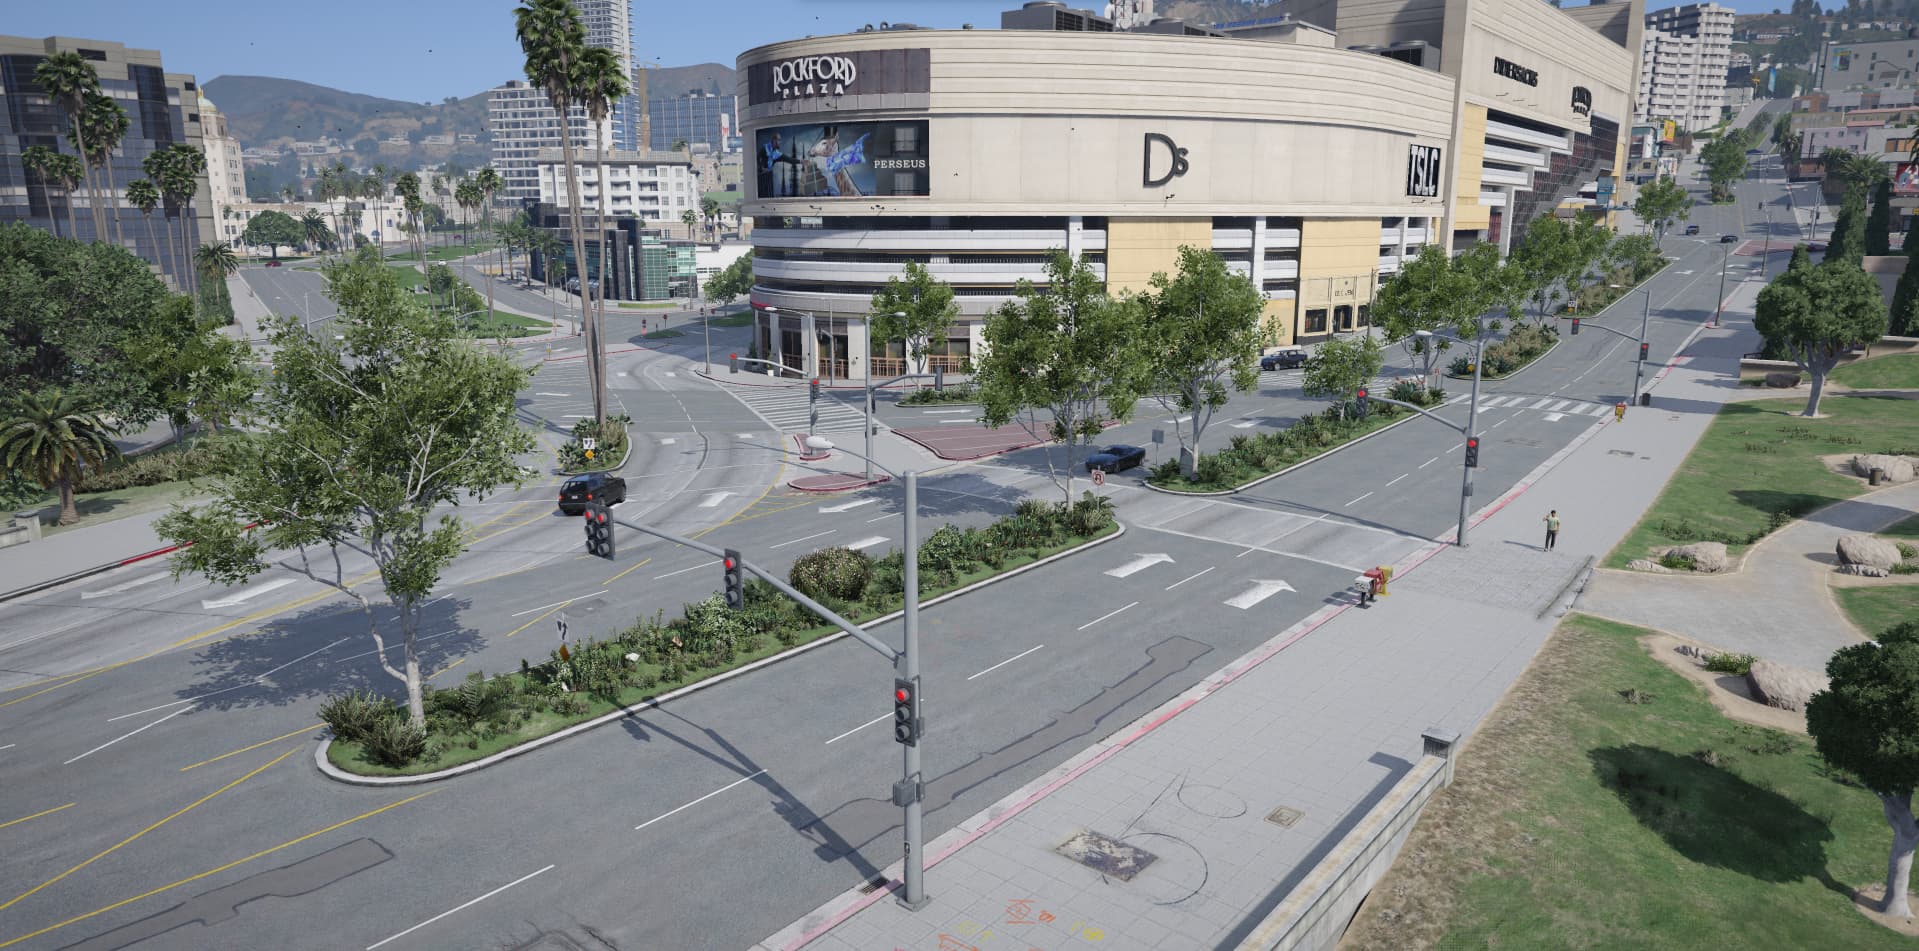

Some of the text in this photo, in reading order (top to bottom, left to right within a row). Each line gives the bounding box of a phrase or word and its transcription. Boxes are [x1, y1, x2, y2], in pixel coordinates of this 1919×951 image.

[773, 56, 856, 93] ROCKFORD
[783, 83, 844, 98] PLAZA
[874, 159, 926, 169] PERSEUS
[1409, 145, 1439, 196] TSLC
